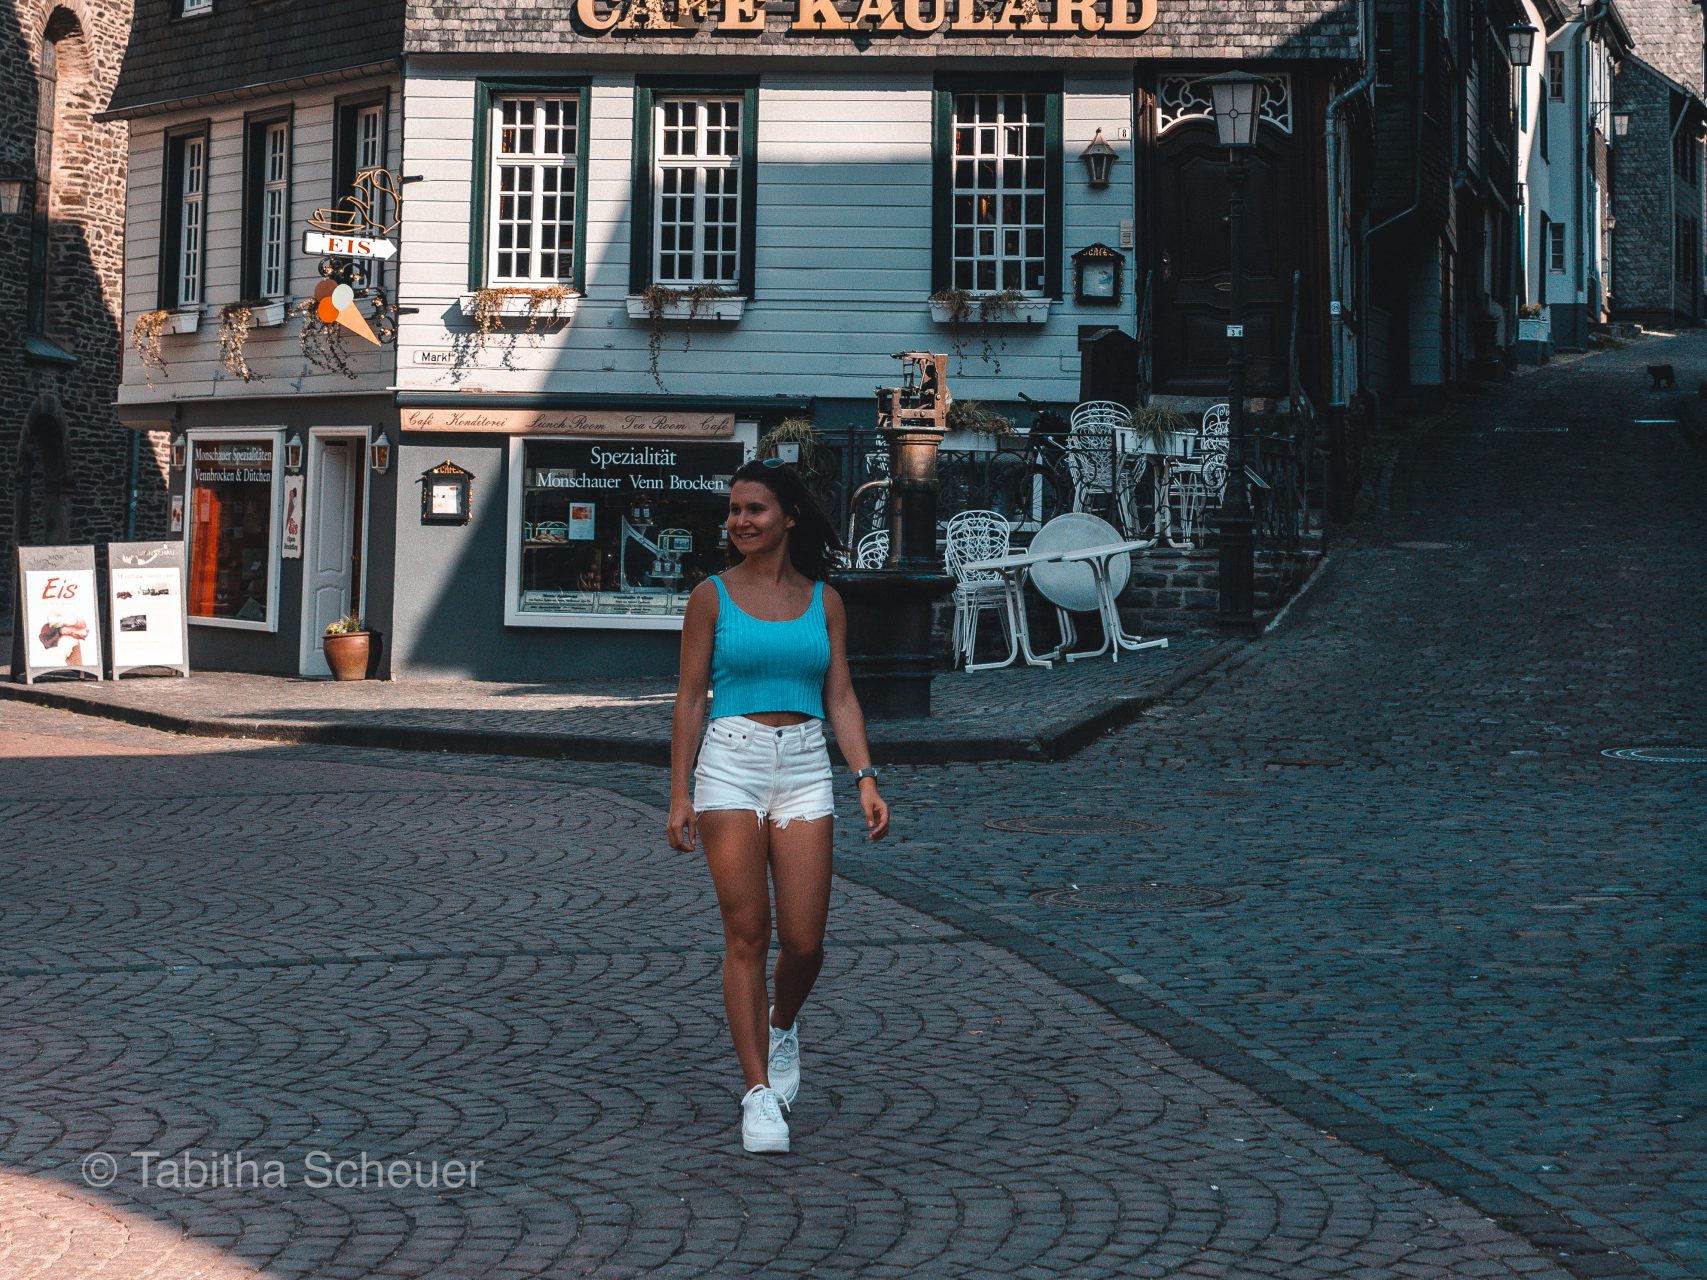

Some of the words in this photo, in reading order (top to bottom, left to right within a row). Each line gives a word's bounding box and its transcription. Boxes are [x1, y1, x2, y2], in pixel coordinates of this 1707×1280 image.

[327, 237, 372, 255] EIS
[407, 411, 434, 430] Café
[445, 412, 507, 427] Konditorei
[525, 414, 566, 429] Lunch
[569, 414, 605, 430] Room
[622, 415, 645, 430] Tea
[649, 415, 687, 430] Room
[700, 416, 729, 434] Café
[195, 448, 232, 461] Monschauer
[232, 448, 272, 465] Spezialitäten
[590, 446, 677, 469] Spezialität
[195, 468, 235, 481] Vennbrocken
[235, 468, 242, 481] &
[243, 468, 271, 482] Dütchen
[537, 473, 621, 489] Monschauer
[629, 474, 664, 489] Venn
[670, 474, 724, 490] Brocken
[42, 577, 78, 600] Eis
